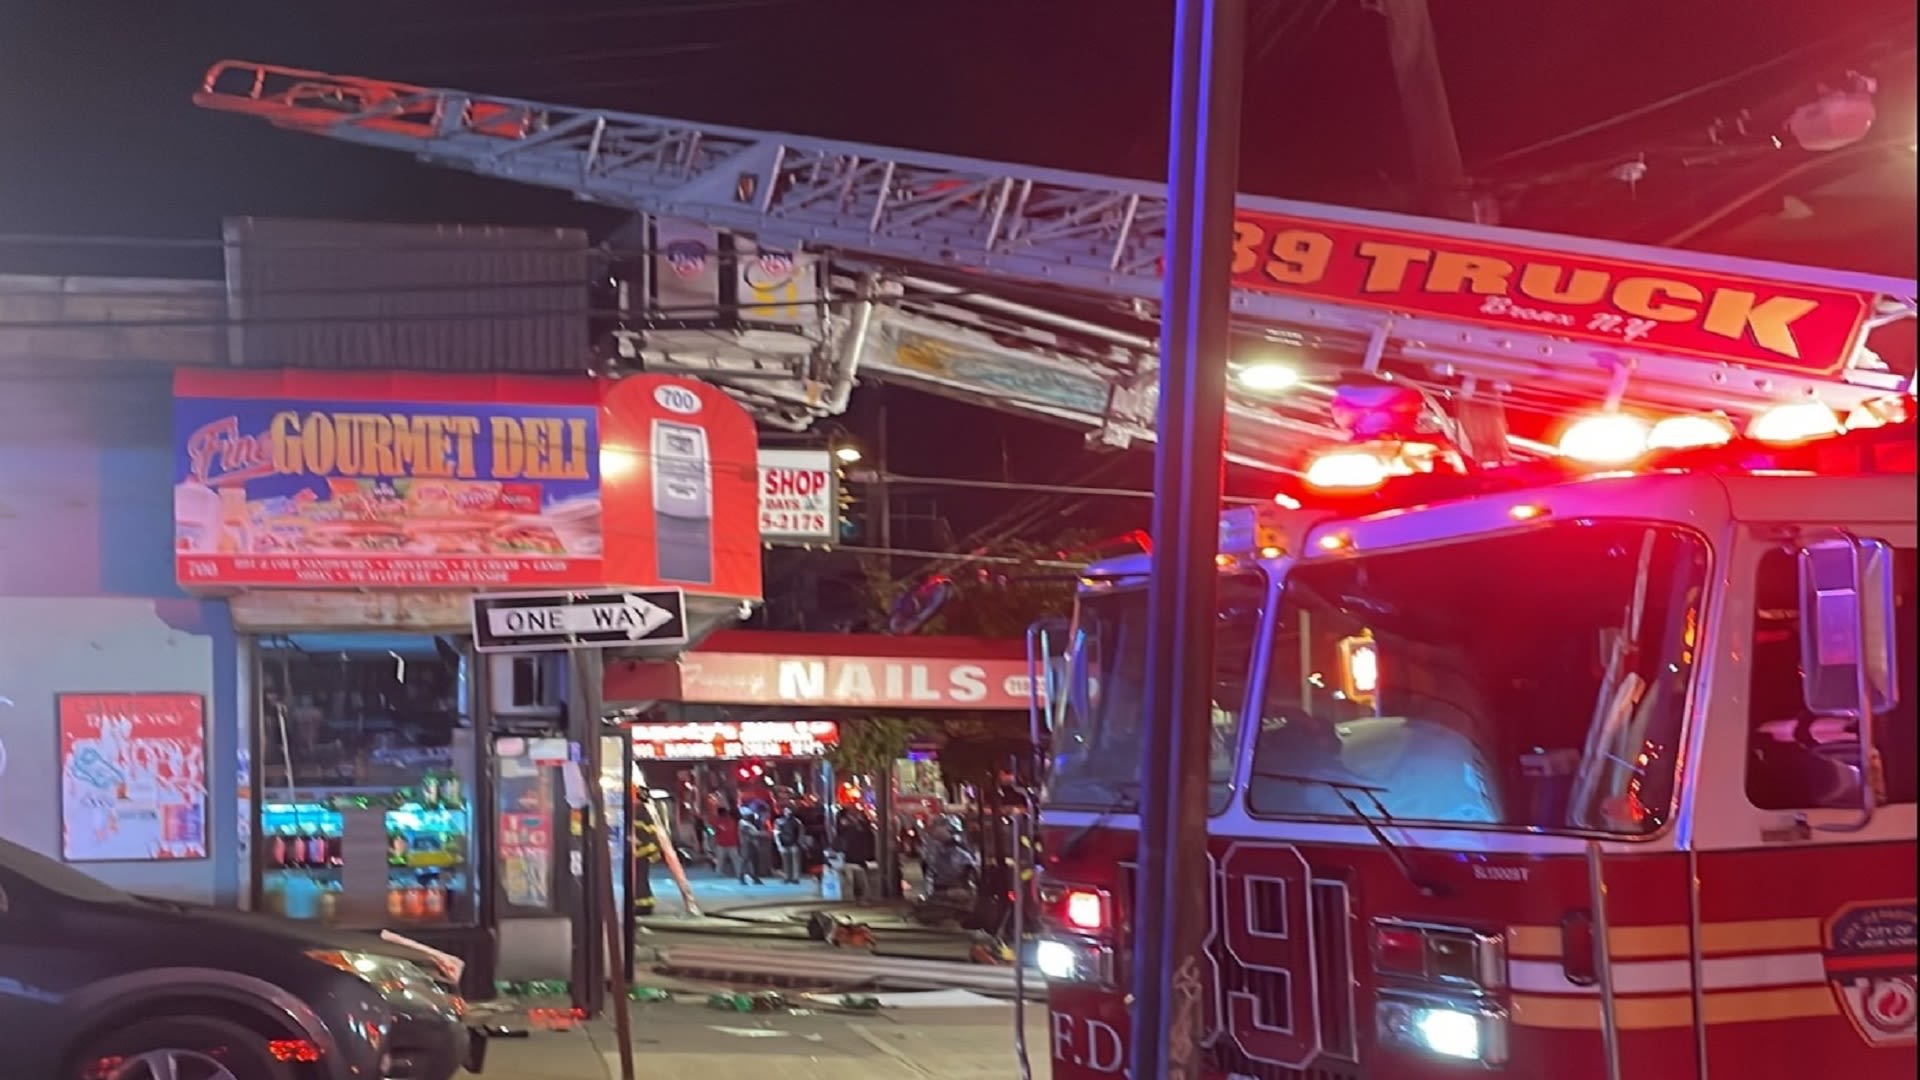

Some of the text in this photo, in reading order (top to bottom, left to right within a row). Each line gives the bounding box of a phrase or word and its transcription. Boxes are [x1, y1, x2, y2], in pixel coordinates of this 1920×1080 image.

[1358, 241, 1820, 359] TRUCK
[1479, 295, 1575, 326] Bronx
[661, 387, 694, 411] 700
[270, 411, 480, 477] GOURMET
[489, 416, 590, 480] DELI
[765, 469, 825, 496] SHOP
[188, 559, 218, 576] 700
[506, 606, 650, 632] ONE WAY
[778, 660, 986, 700] NAILS
